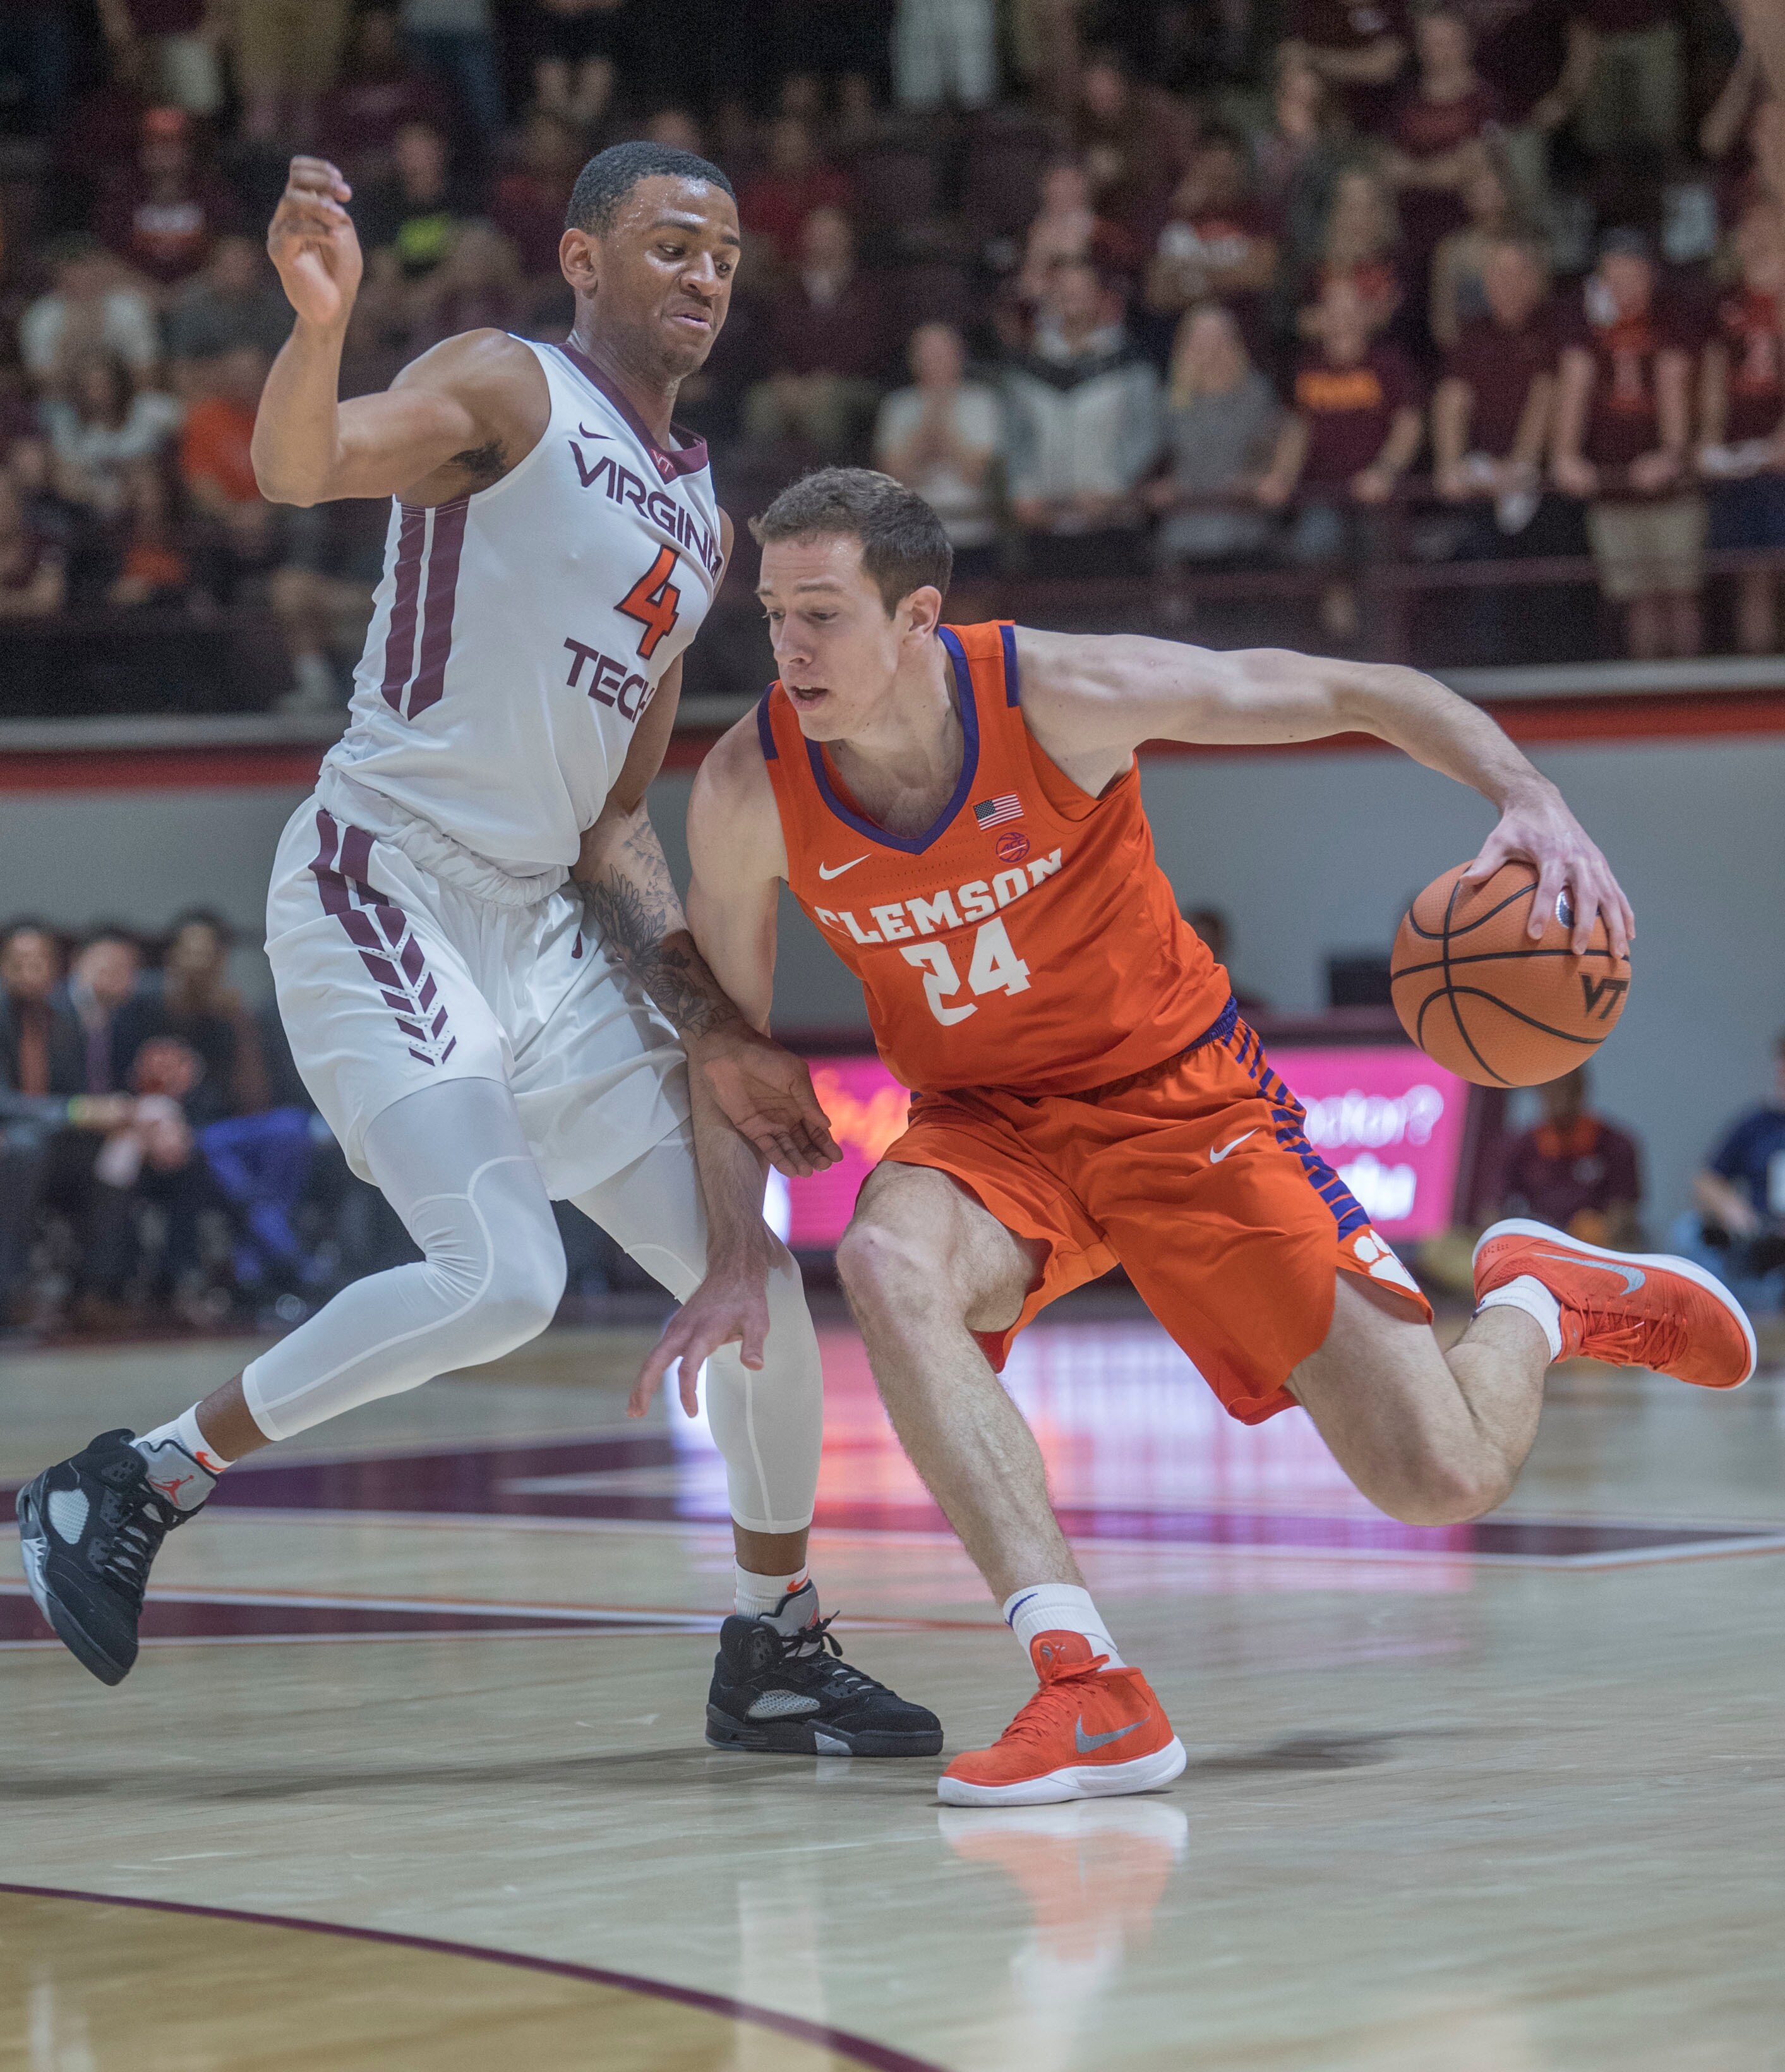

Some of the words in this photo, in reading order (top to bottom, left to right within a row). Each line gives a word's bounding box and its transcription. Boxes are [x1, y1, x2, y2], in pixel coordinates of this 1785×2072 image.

[651, 449, 674, 474] VT
[613, 544, 680, 660] 4
[563, 637, 655, 723] TECH
[899, 916, 1031, 1026] 24
[1580, 973, 1630, 1020] VT
